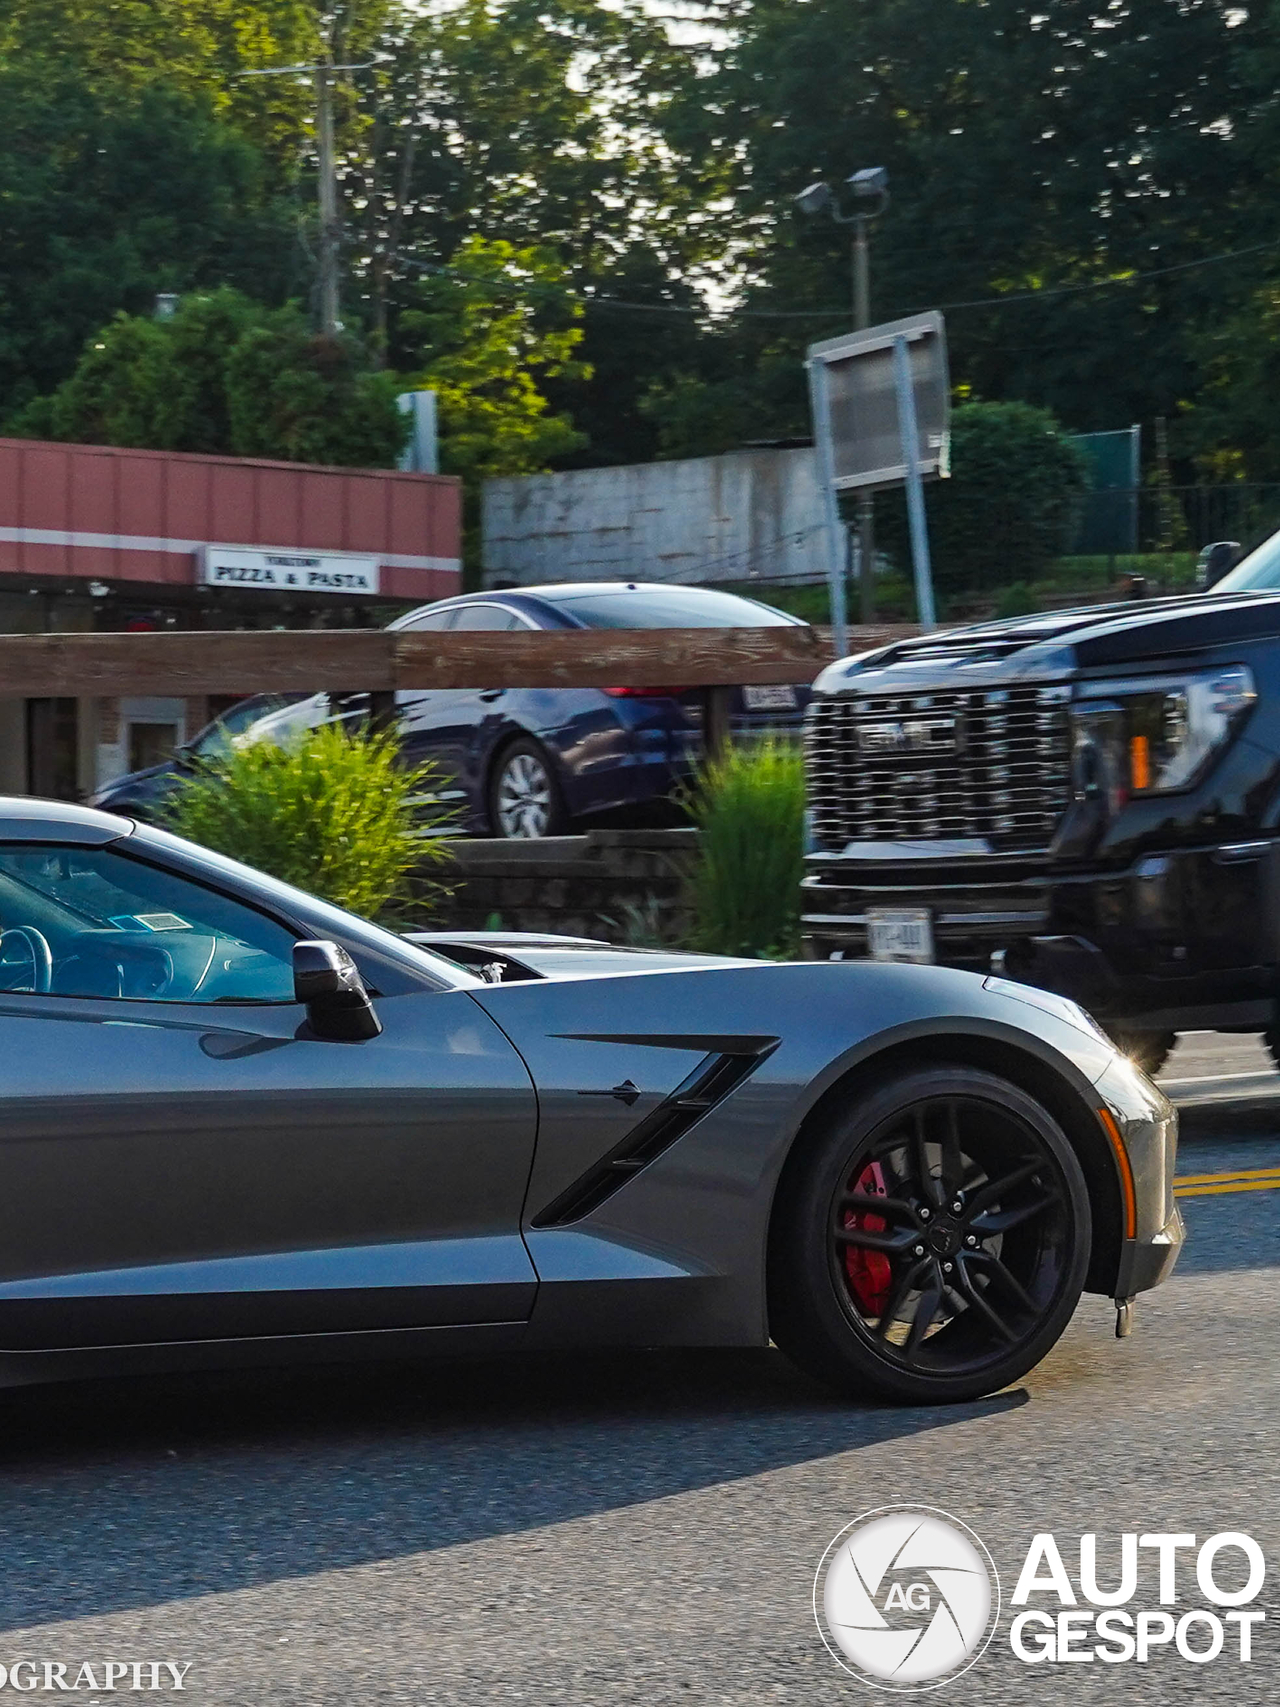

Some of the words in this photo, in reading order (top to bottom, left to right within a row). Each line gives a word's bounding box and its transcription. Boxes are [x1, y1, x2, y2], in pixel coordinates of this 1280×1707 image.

[214, 566, 277, 583] PIZZA
[285, 573, 299, 585] &
[307, 571, 369, 588] PASTA
